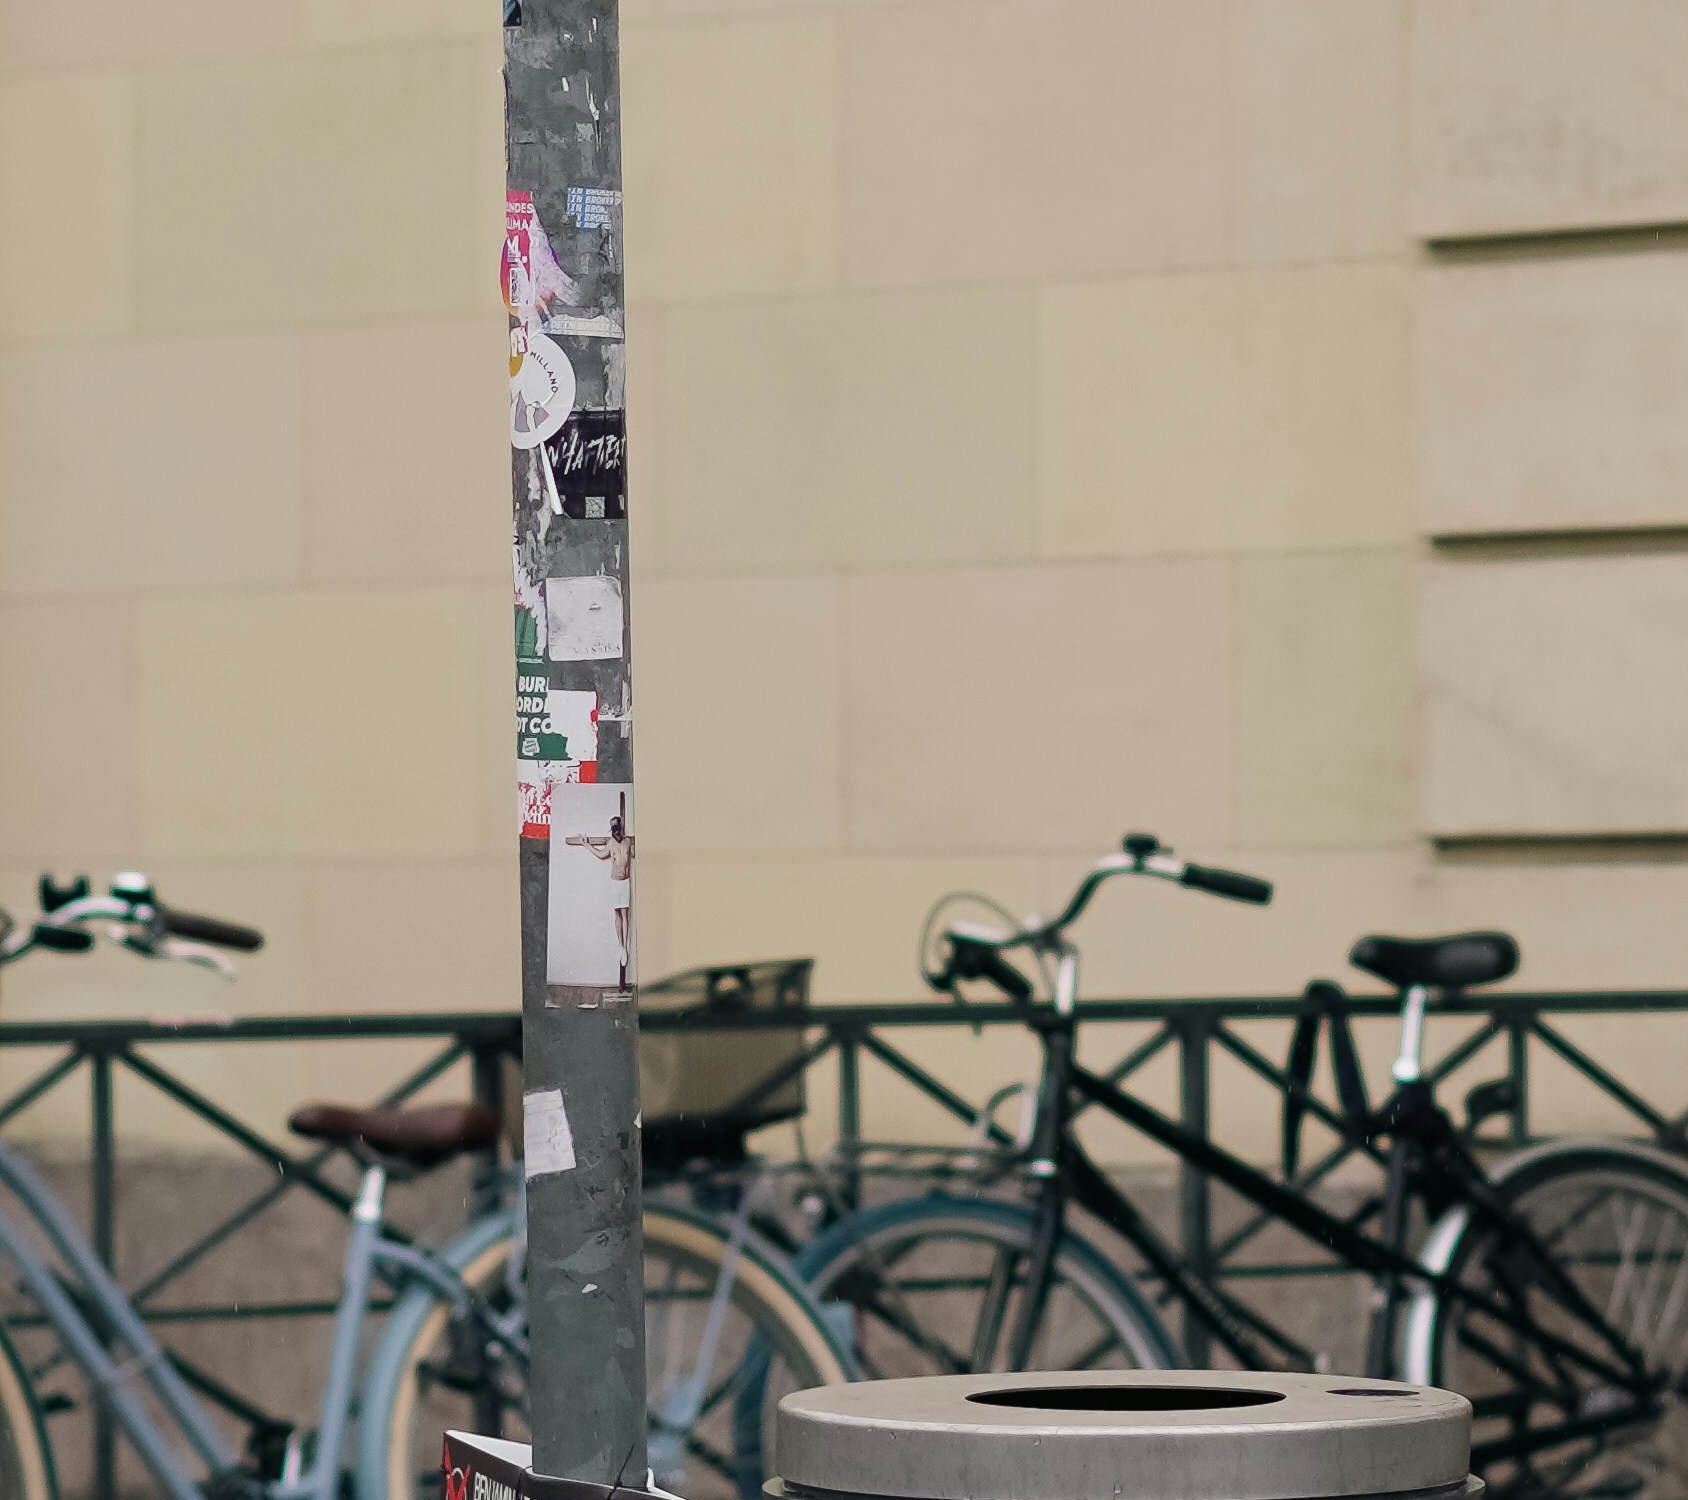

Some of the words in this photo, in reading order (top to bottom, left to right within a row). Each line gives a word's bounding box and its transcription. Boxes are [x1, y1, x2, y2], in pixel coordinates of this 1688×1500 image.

[507, 202, 533, 214] NDES
[517, 697, 549, 713] ORD
[529, 717, 553, 734] CO
